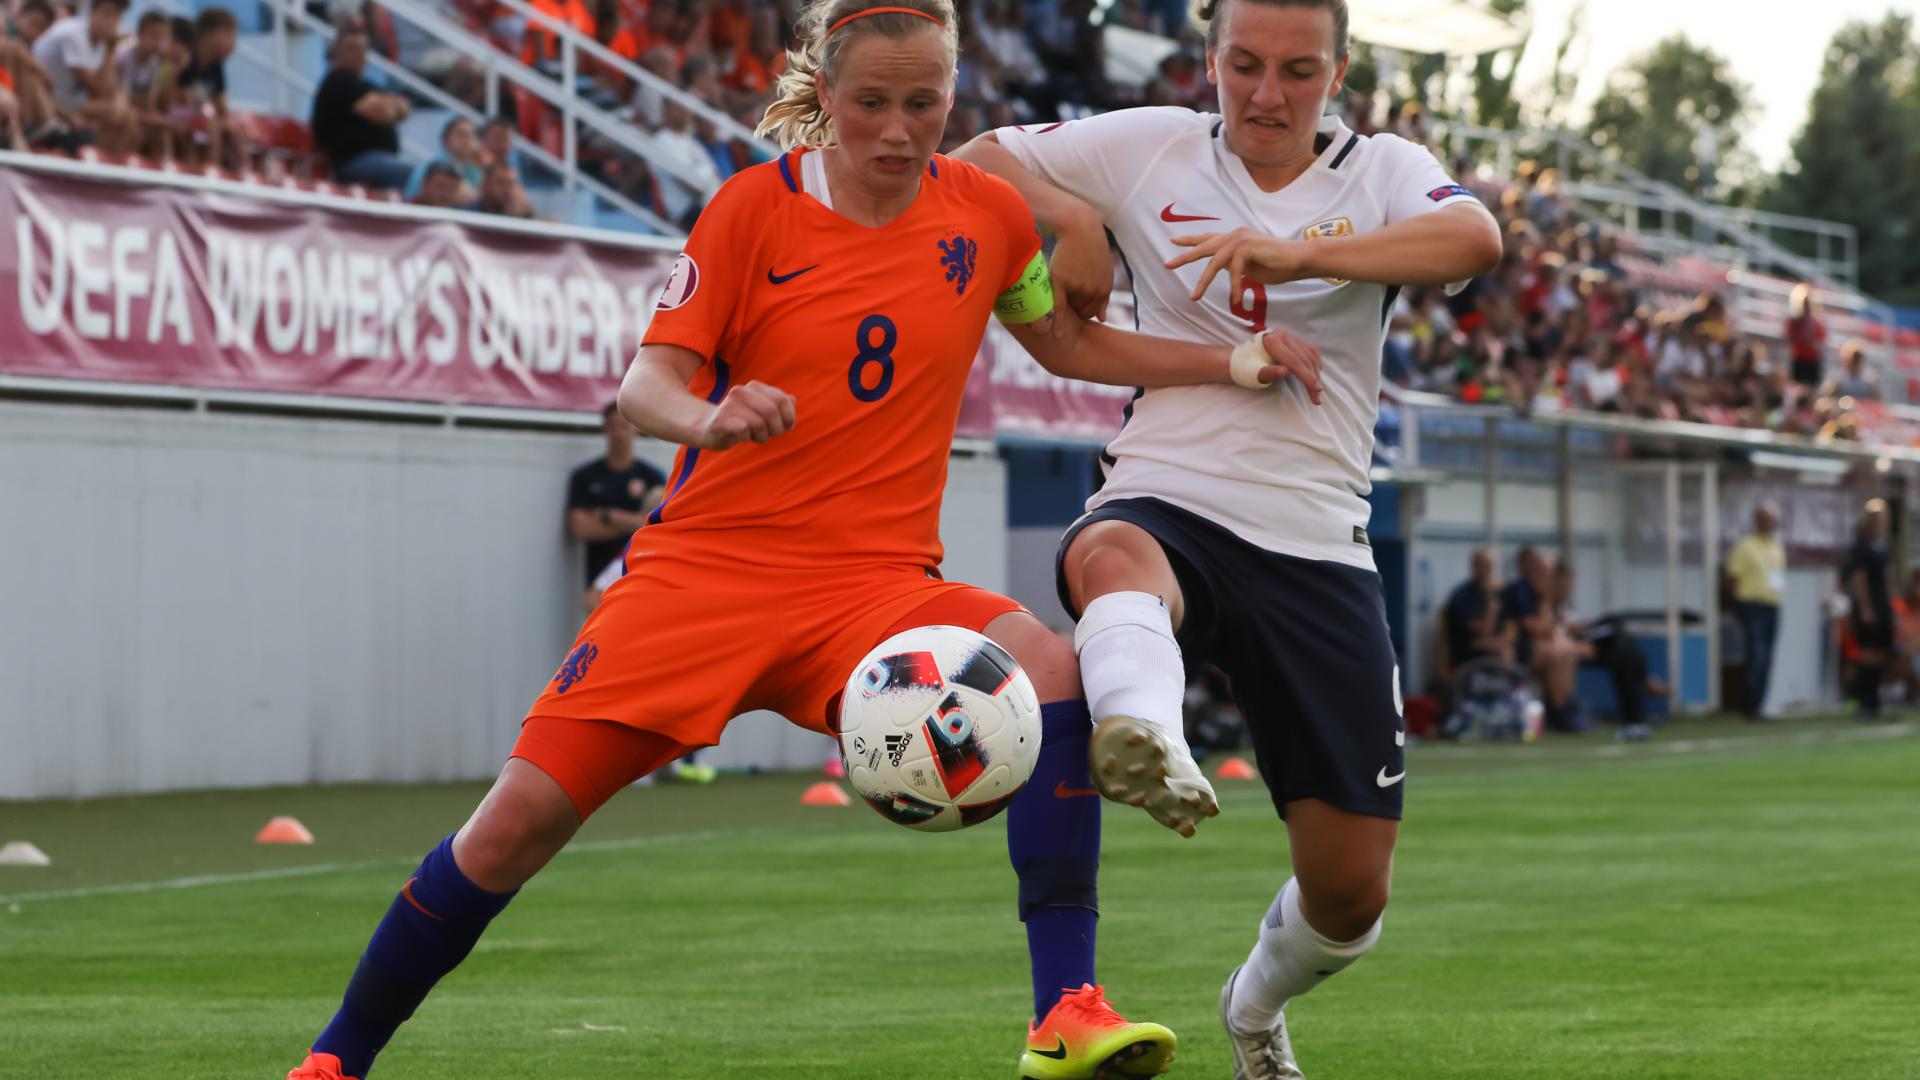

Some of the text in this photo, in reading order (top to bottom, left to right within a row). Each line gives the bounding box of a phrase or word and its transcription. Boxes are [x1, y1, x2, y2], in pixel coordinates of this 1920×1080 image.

[17, 214, 664, 378] UEFA WOMEN'S UNDER 1
[847, 313, 898, 403] 8
[891, 732, 914, 768] adidas
